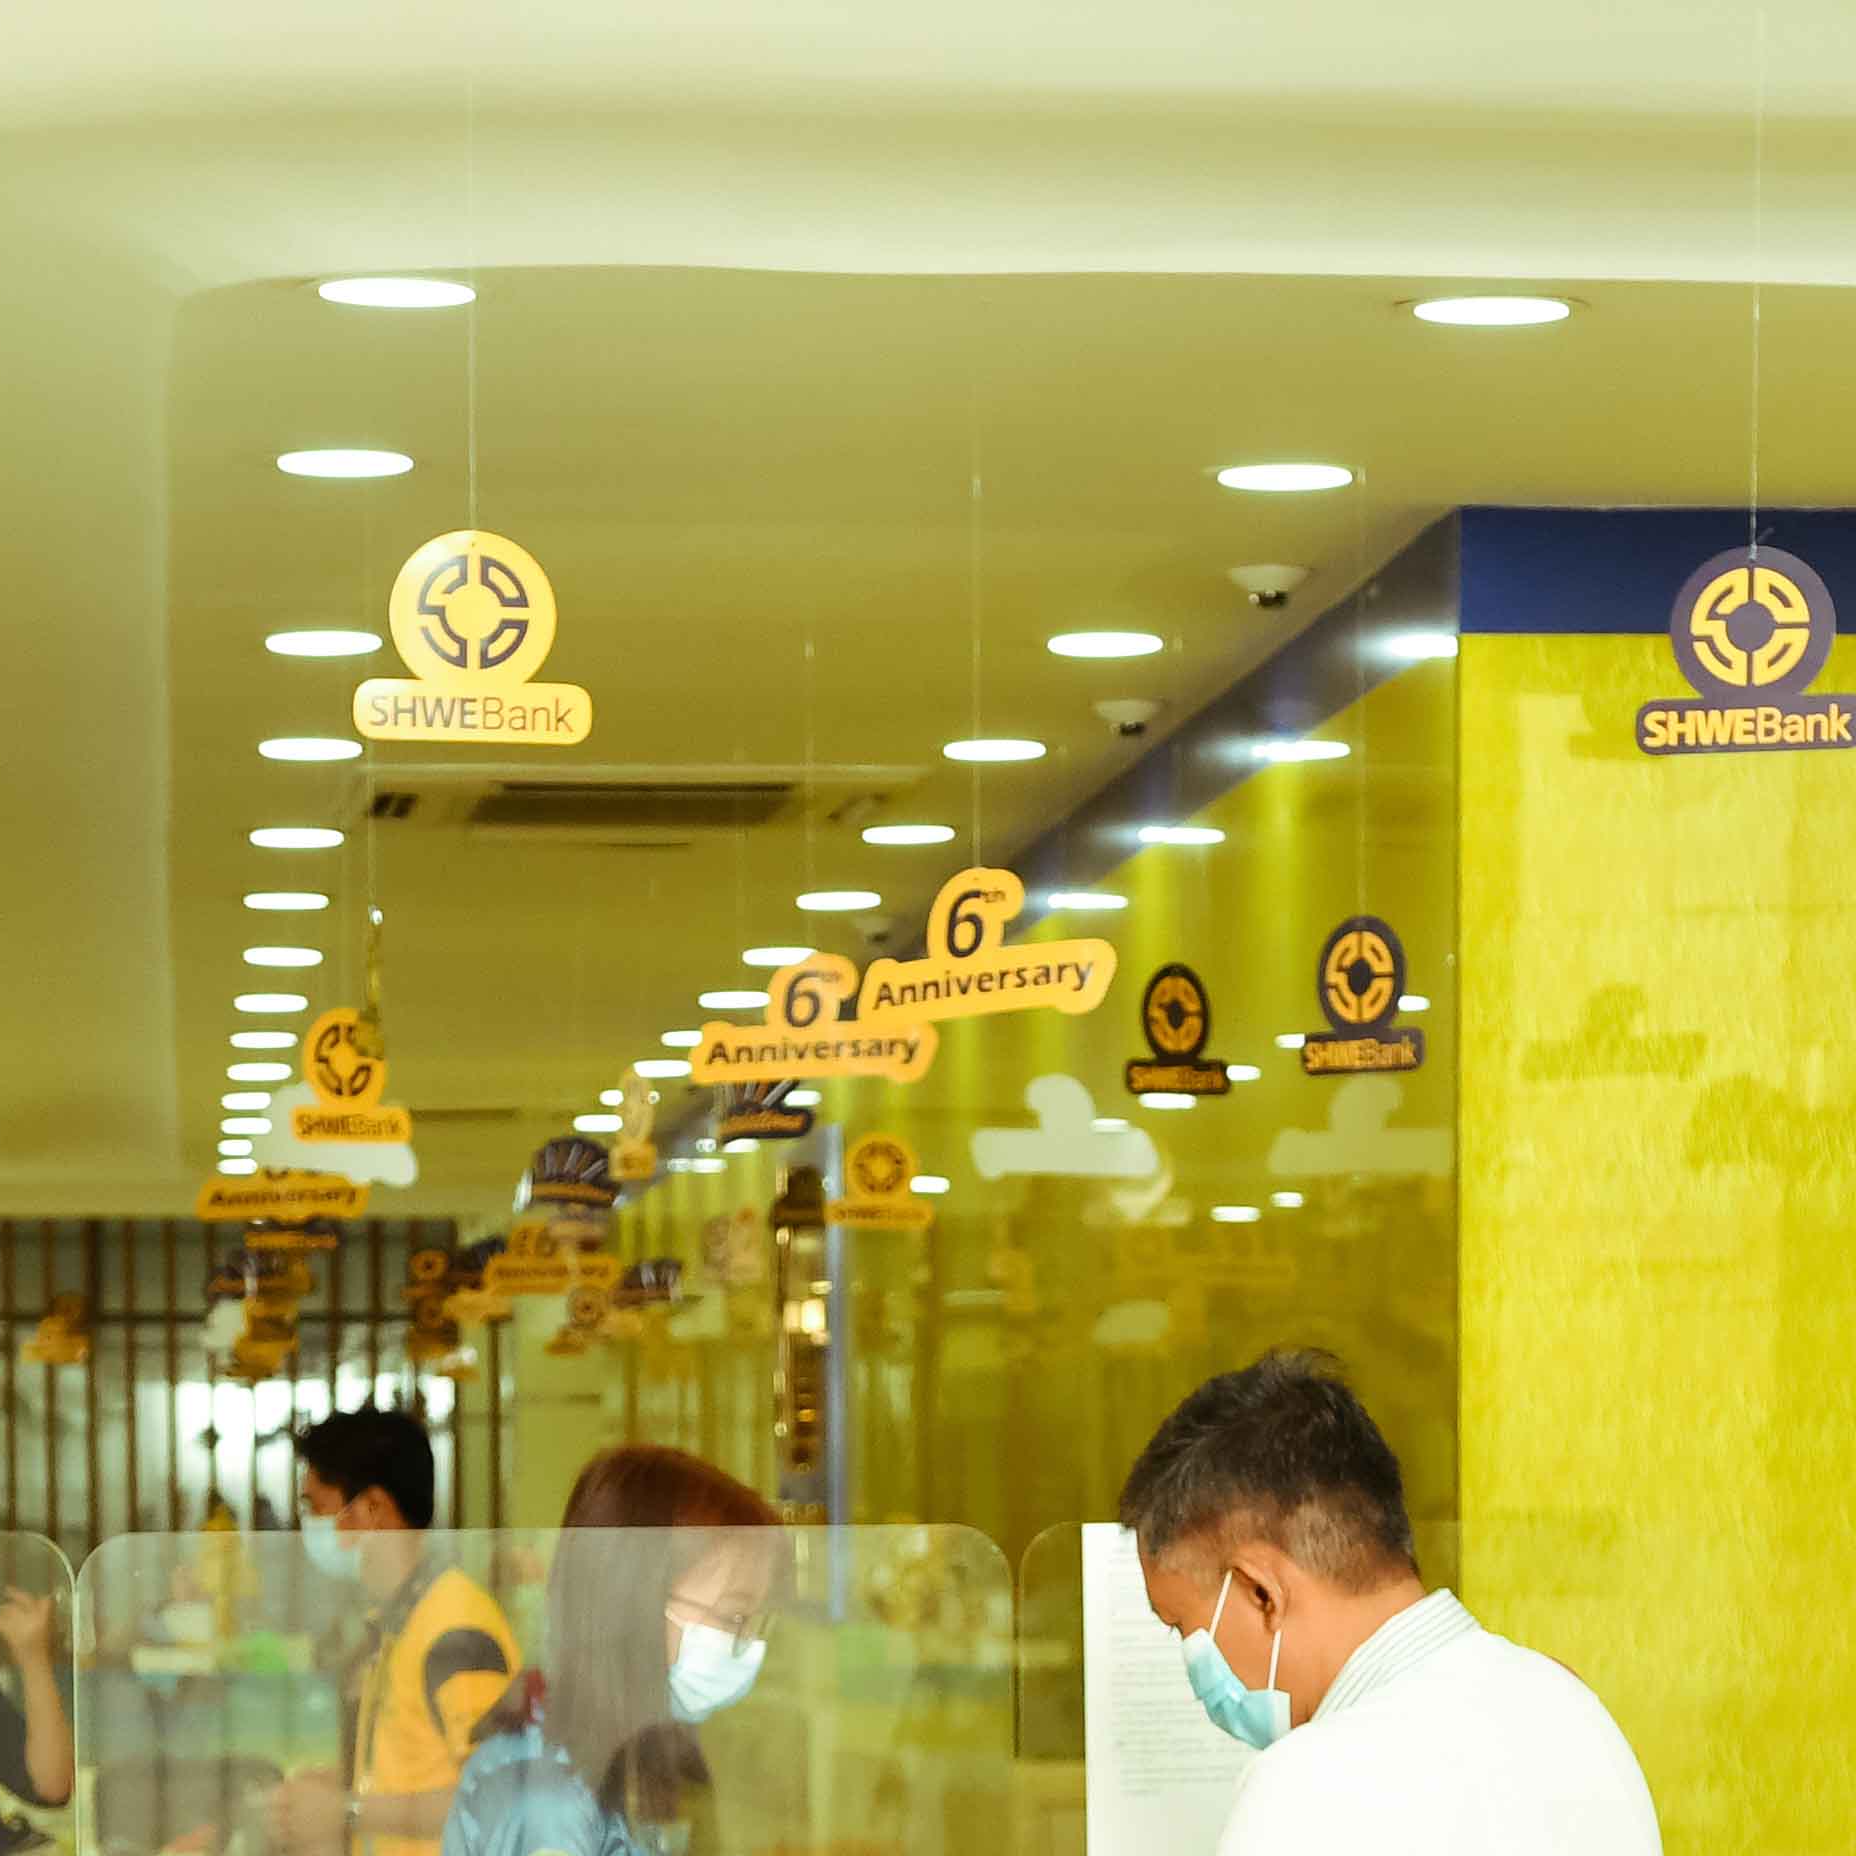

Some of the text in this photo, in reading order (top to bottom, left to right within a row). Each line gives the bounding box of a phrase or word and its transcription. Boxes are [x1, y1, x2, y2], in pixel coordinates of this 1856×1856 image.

[370, 695, 574, 733] SHWEBank
[1643, 703, 1853, 748] SHWEBank
[872, 958, 1095, 1011] Anniversary
[705, 1034, 920, 1067] Anniversary
